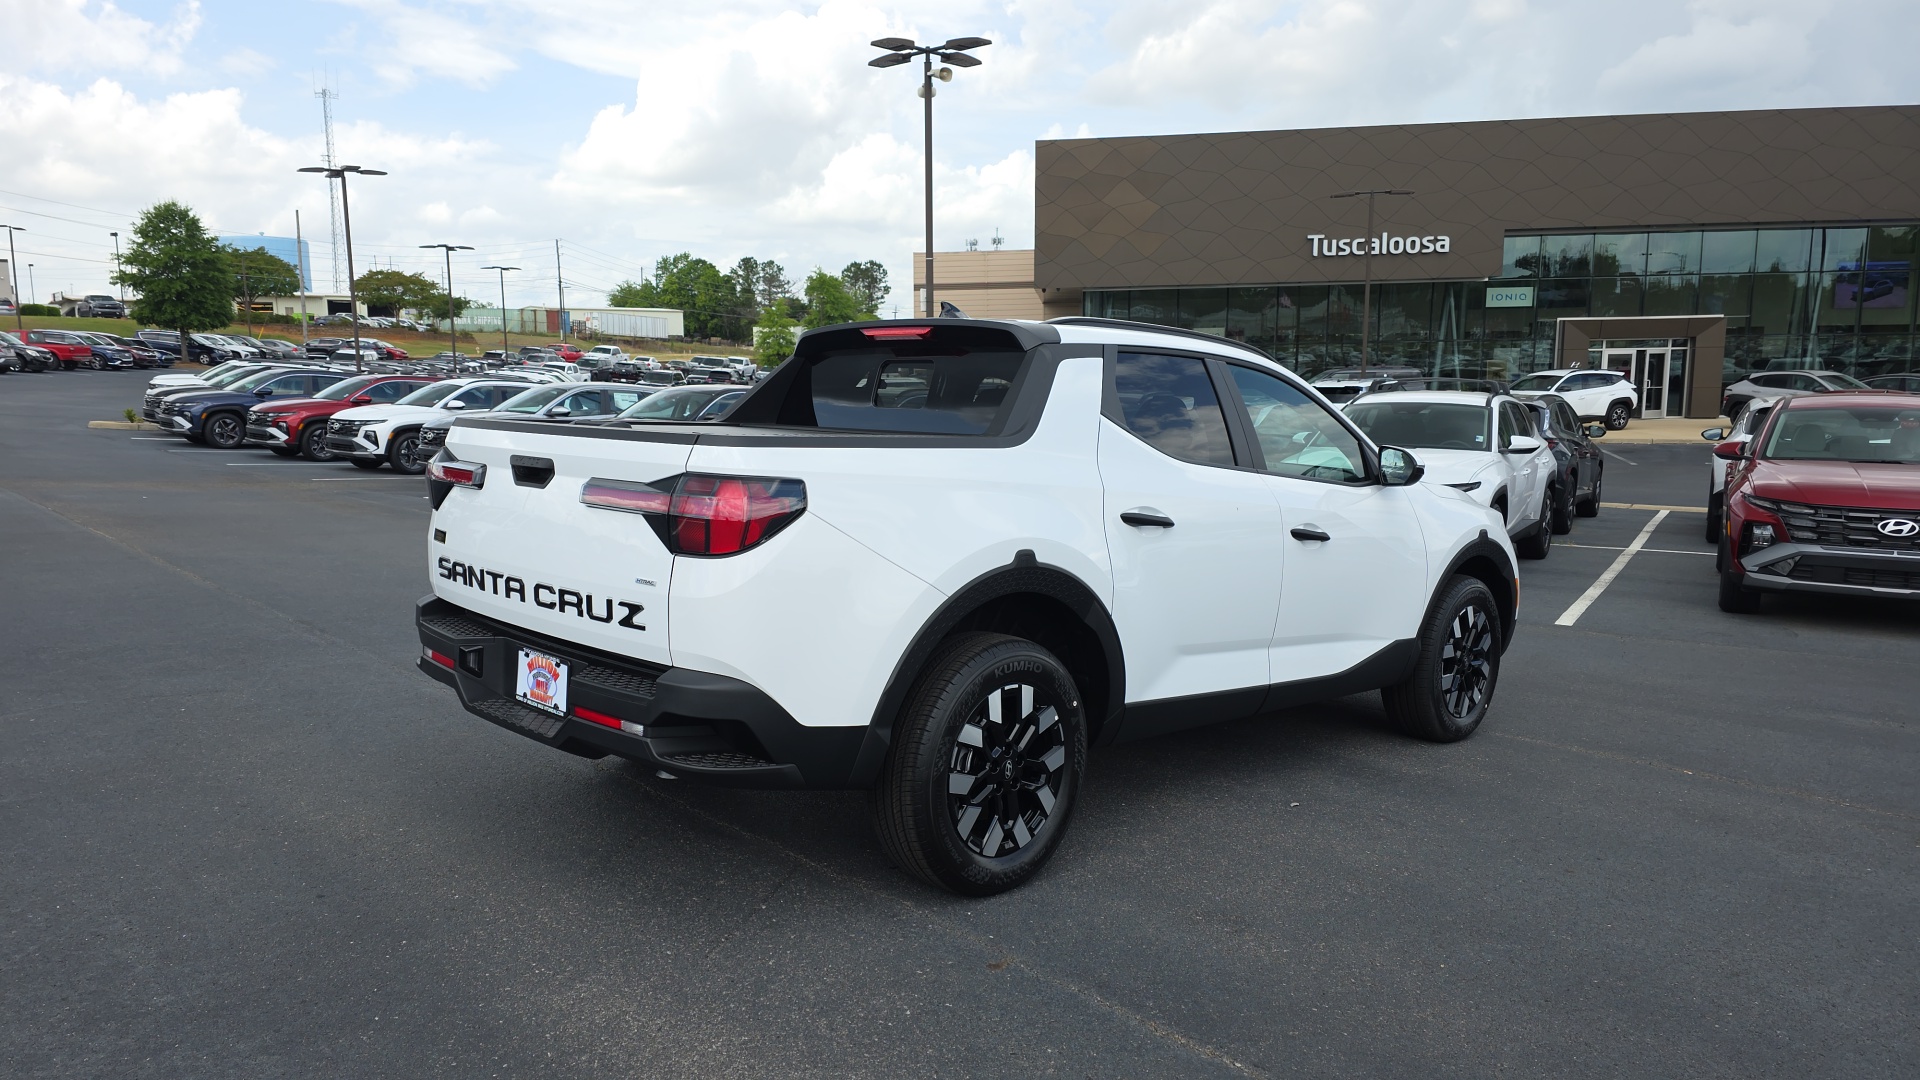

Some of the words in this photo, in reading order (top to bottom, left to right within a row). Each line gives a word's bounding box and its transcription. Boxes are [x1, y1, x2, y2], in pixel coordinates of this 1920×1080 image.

[1307, 232, 1450, 257] Tuscaloosa
[1491, 292, 1527, 302] IONIQ
[454, 316, 471, 325] CHINA
[474, 316, 502, 325] SHIPPING
[438, 556, 526, 602] SANTA
[533, 583, 646, 631] CRUZ
[527, 656, 560, 682] MILLION
[994, 660, 1043, 678] KUMHO
